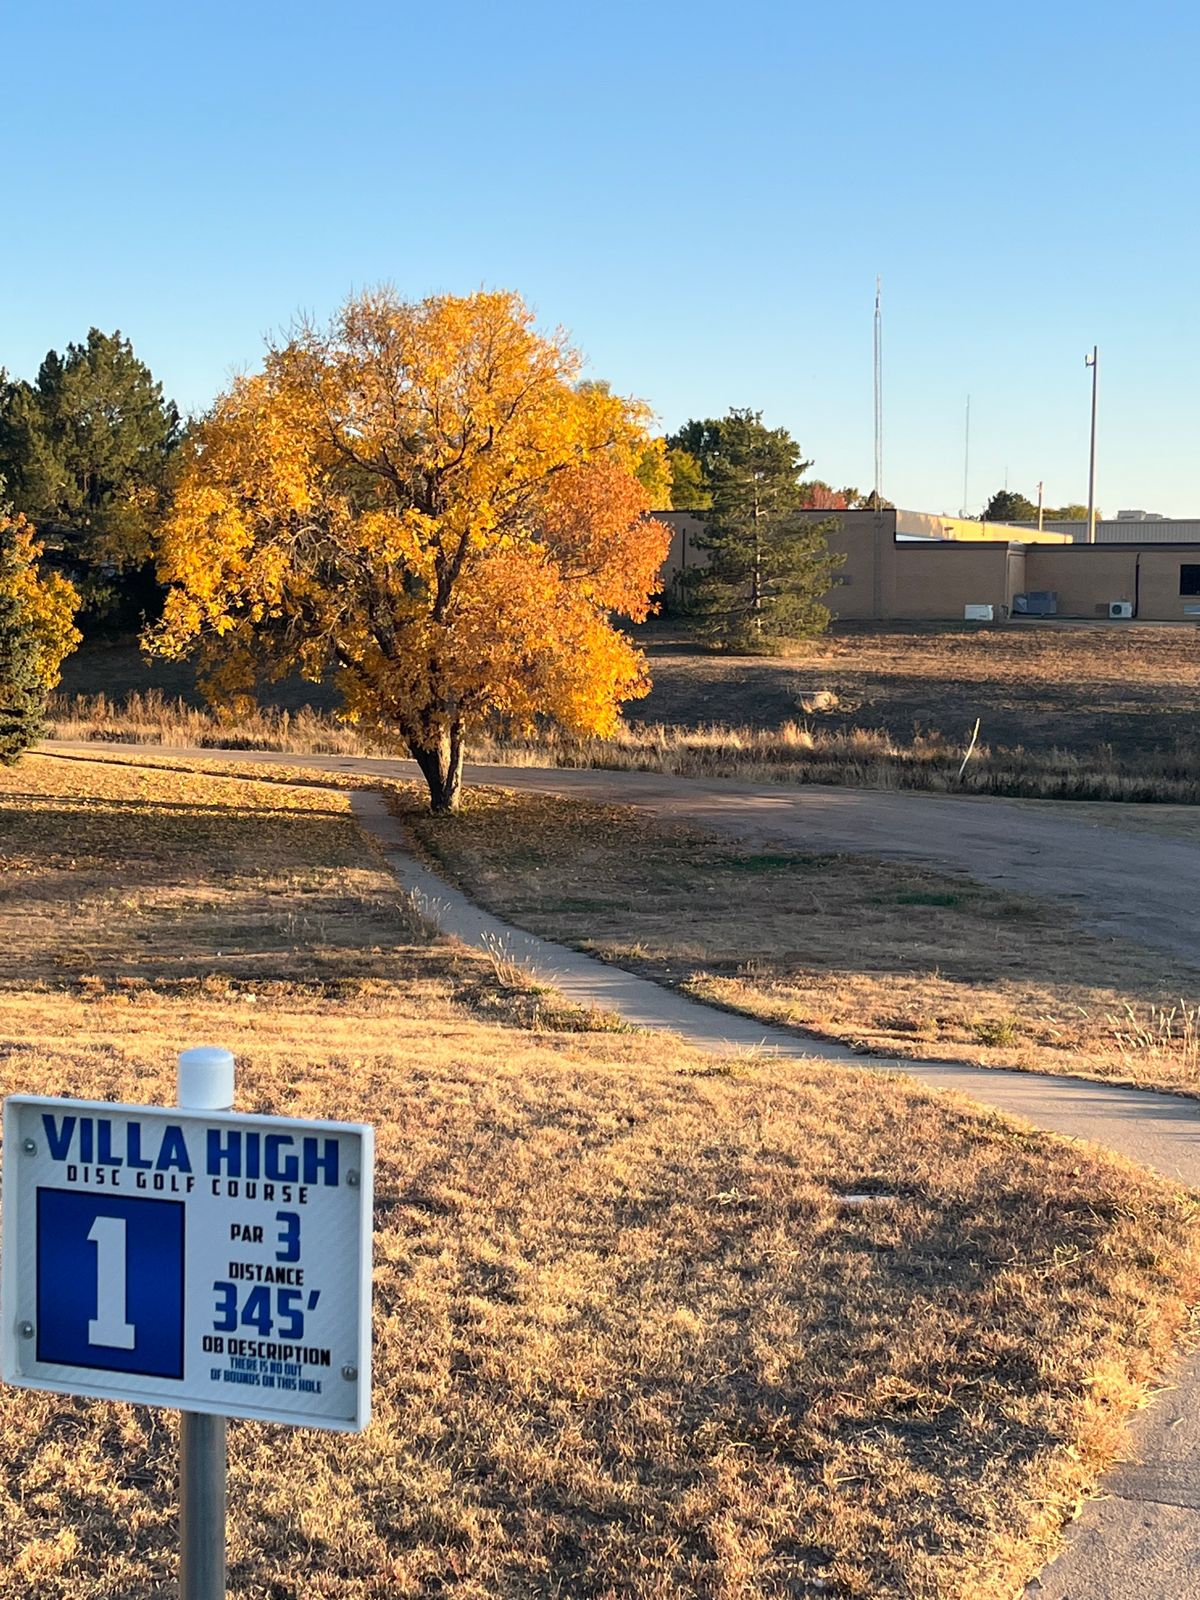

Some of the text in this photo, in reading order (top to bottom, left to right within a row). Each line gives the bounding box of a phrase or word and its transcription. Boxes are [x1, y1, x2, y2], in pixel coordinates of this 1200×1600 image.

[42, 1114, 339, 1186] VILLA HIGH
[67, 1165, 308, 1204] DISC GOLF COURSE
[230, 1211, 301, 1263] PAR 3
[86, 1215, 136, 1350] 1
[228, 1262, 304, 1286] DISTANCE
[213, 1281, 321, 1340] 345'
[202, 1335, 331, 1366] OB DESCRIPTION
[230, 1357, 302, 1377] THERE IS NO OUT
[210, 1368, 322, 1394] OF BOUNDS ON THIS HOLE
